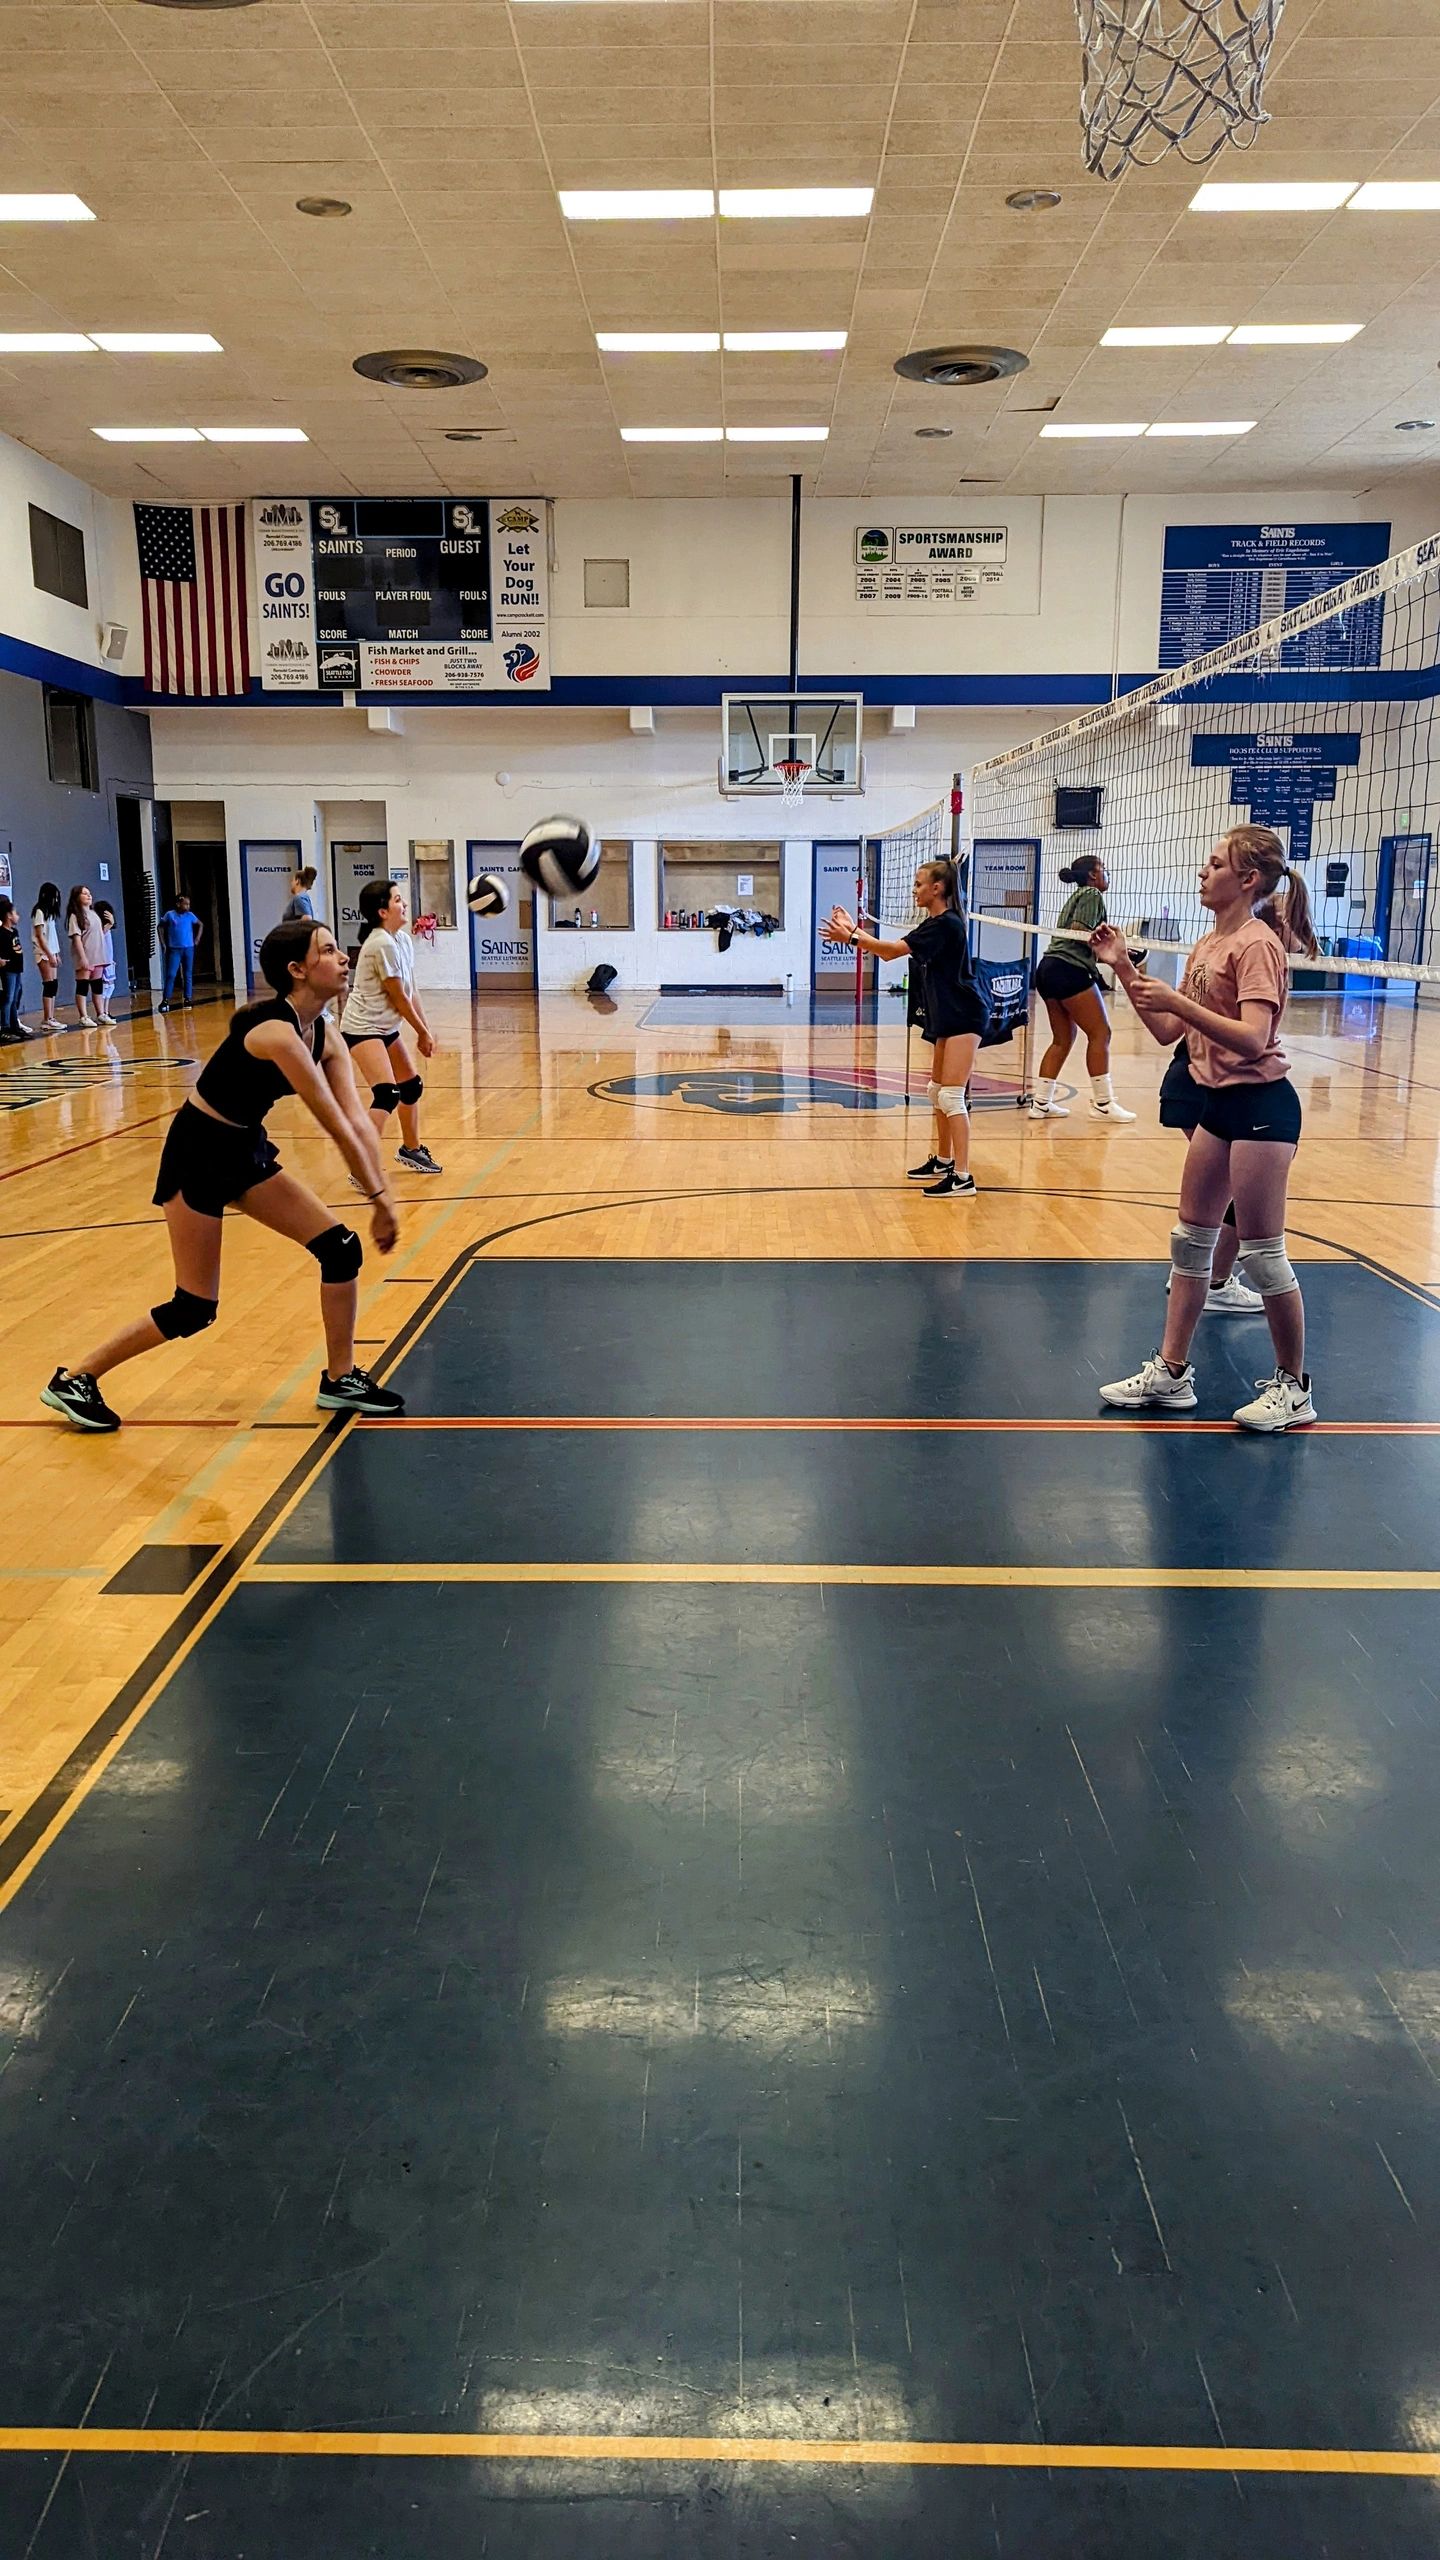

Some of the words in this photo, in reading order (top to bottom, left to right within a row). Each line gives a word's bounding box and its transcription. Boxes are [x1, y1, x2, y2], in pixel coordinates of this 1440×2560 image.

[1260, 526, 1296, 539] SAINTS
[899, 532, 1004, 545] SPORTSMANSHIP
[1230, 540, 1257, 548] TRACK
[1289, 538, 1326, 547] RECORDS
[318, 540, 364, 554] SAINTS
[439, 540, 482, 554] GUEST
[508, 542, 530, 555] Let
[385, 548, 417, 558] PERIOD
[928, 547, 973, 559] AWARD
[503, 560, 535, 572] Your
[264, 572, 305, 598] GO
[505, 576, 534, 591] Dog
[318, 590, 346, 600] FOULS
[375, 590, 408, 600] PLAYER
[409, 590, 432, 600] FOUL
[459, 590, 488, 600] FOULS
[501, 593, 539, 605] RUN!!
[262, 603, 310, 619] SAINTS!
[319, 629, 348, 639] SCORE
[388, 629, 419, 639] MATCH
[460, 629, 489, 639] SCORE
[501, 630, 522, 638] Alumni
[523, 630, 541, 638] 2002
[367, 646, 388, 656] Fish
[389, 646, 425, 656] Market
[426, 646, 445, 656] and
[447, 646, 478, 656] Grill...
[374, 658, 391, 666] FISH
[391, 658, 398, 666] &
[398, 658, 420, 666] CHIPS
[374, 668, 412, 676] CHOWDER
[375, 679, 398, 687] FRESH
[399, 679, 434, 687] SEAFOOD
[1256, 734, 1294, 747] SAINTS
[481, 939, 529, 955] SAINTS
